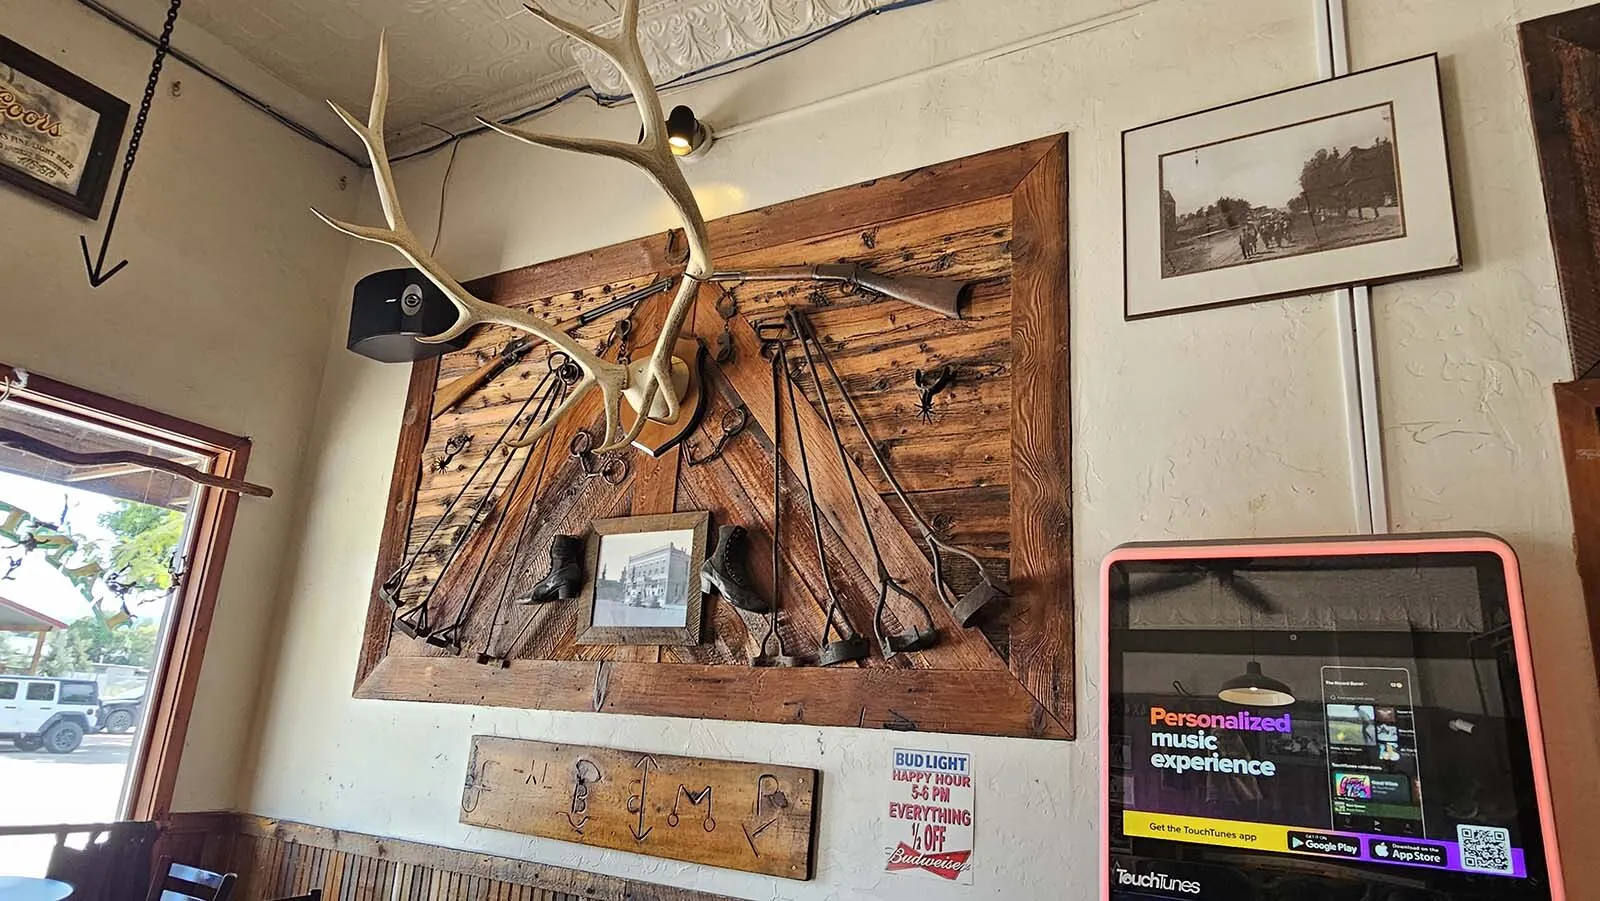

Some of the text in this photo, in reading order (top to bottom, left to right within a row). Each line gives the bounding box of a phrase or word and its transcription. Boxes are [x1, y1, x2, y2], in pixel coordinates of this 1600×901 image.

[56, 152, 75, 170] BEER
[1151, 707, 1291, 733] Personalized
[1151, 730, 1218, 750] music
[895, 752, 967, 771] BUD LIGHT
[1151, 752, 1276, 777] experience
[892, 769, 971, 788] HAPPY HOUR
[911, 784, 951, 803] 5-6 PM
[889, 802, 971, 826] EVERYTHING
[924, 824, 947, 852] OFF
[1149, 822, 1257, 842] Get the TouchTunes app
[1305, 839, 1358, 856] Google Play
[1392, 843, 1420, 852] Download
[1392, 850, 1441, 863] App Store
[888, 847, 971, 873] Budweiser
[1116, 868, 1201, 894] TouchTunes
